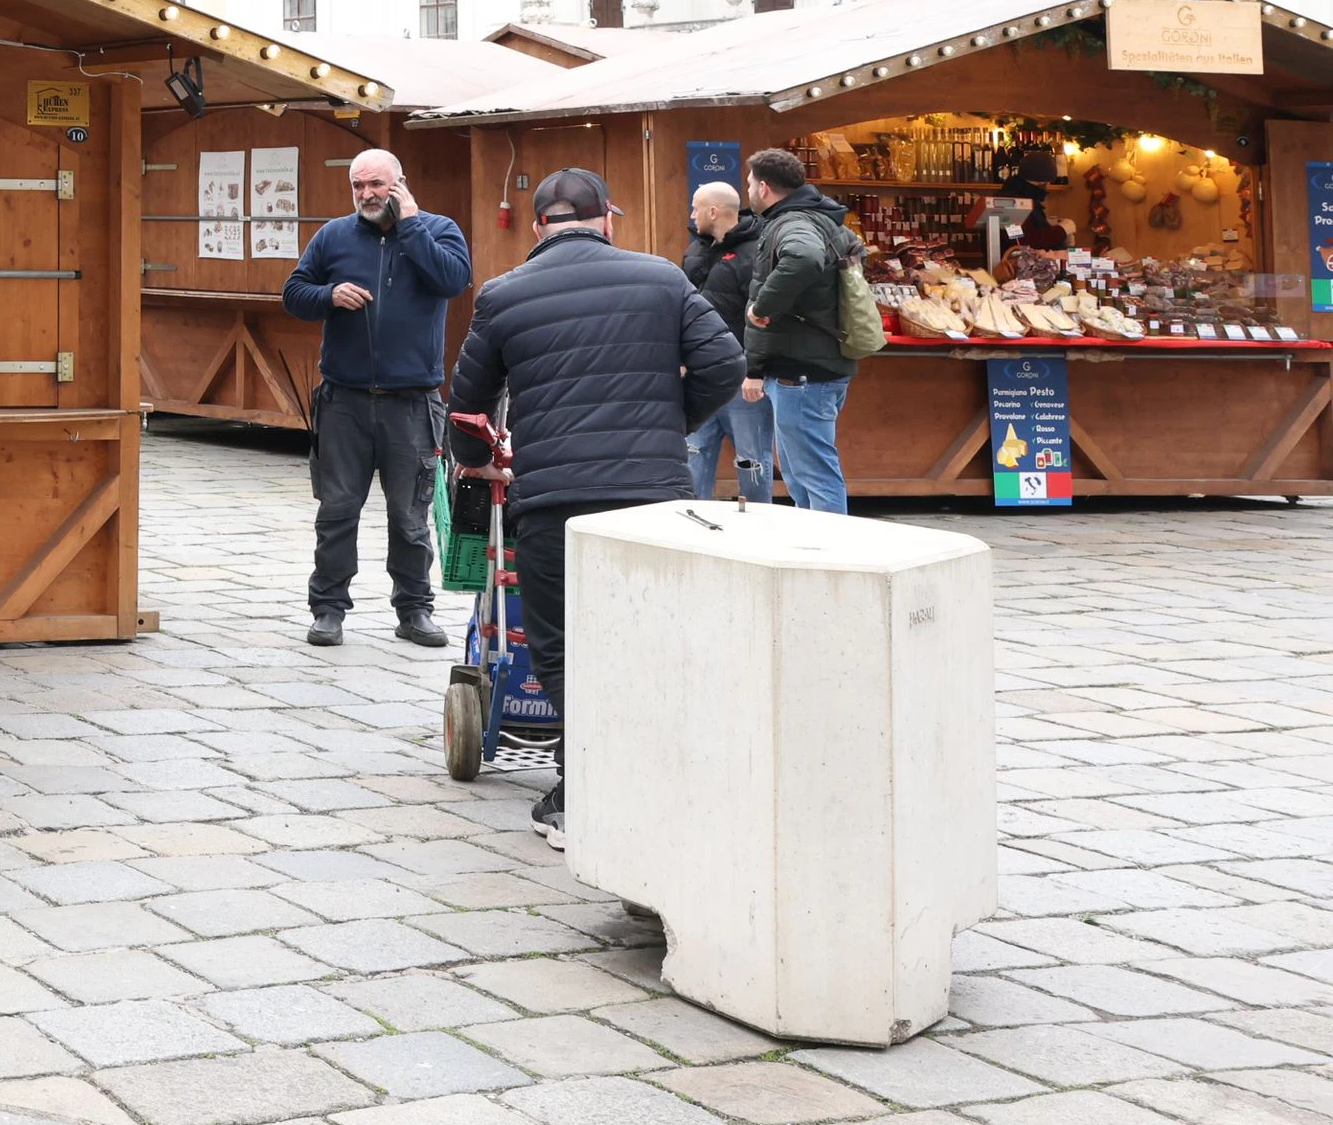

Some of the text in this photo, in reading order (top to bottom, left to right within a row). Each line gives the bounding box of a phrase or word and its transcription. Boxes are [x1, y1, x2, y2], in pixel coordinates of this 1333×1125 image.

[1161, 30, 1212, 45] GORONI
[1196, 54, 1215, 64] aus
[1218, 53, 1253, 65] Italien
[71, 132, 84, 141] 10
[1016, 371, 1039, 379] GORONI
[993, 386, 1055, 398] Parmigiano Pesto
[1034, 401, 1065, 409] Genovese
[1035, 413, 1066, 421] Calabrese
[1036, 425, 1055, 433] Rosso
[1036, 437, 1063, 445] Piccante
